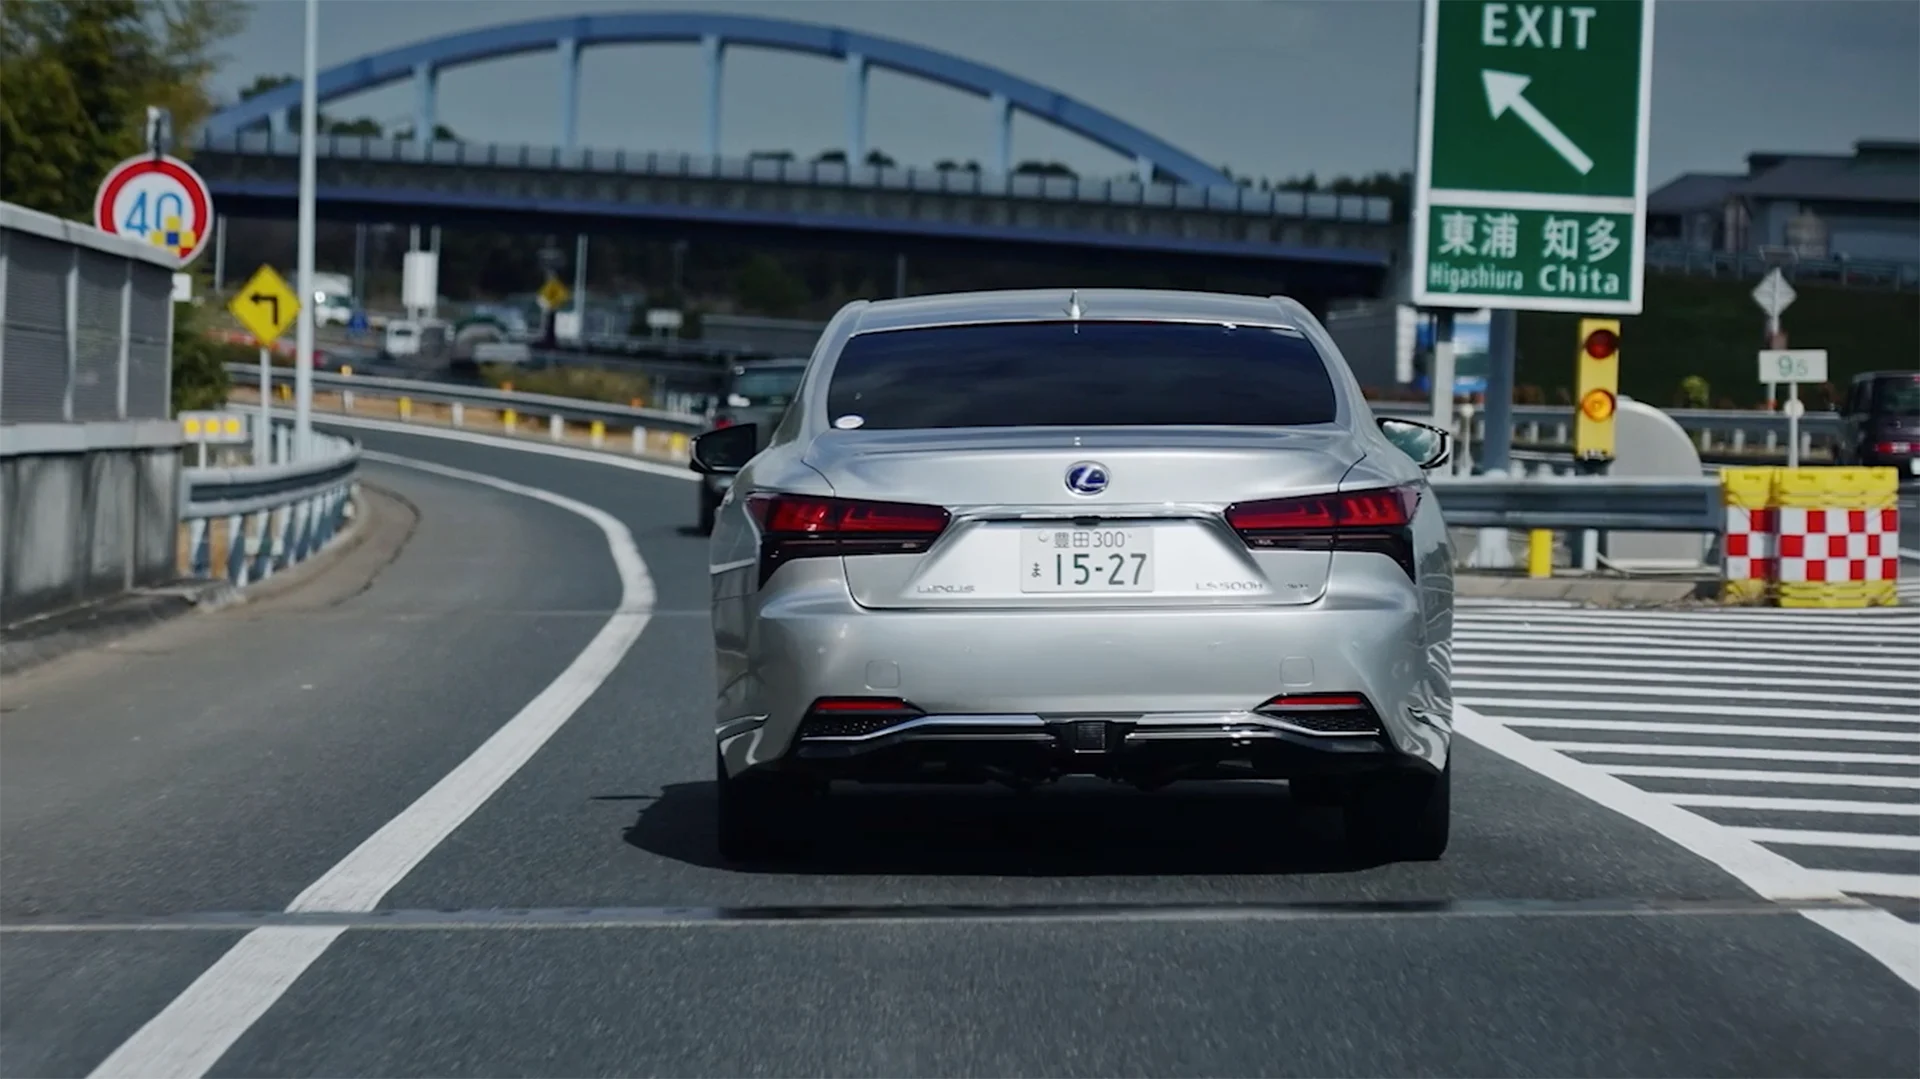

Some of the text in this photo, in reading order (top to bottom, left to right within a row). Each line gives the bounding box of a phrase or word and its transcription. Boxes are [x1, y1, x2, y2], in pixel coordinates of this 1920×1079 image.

[1482, 3, 1597, 50] EXIT
[125, 190, 183, 237] 40
[1438, 211, 1621, 263] 東浦 知多
[1429, 262, 1620, 294] Higashiura Chita
[1056, 553, 1147, 585] 15-27
